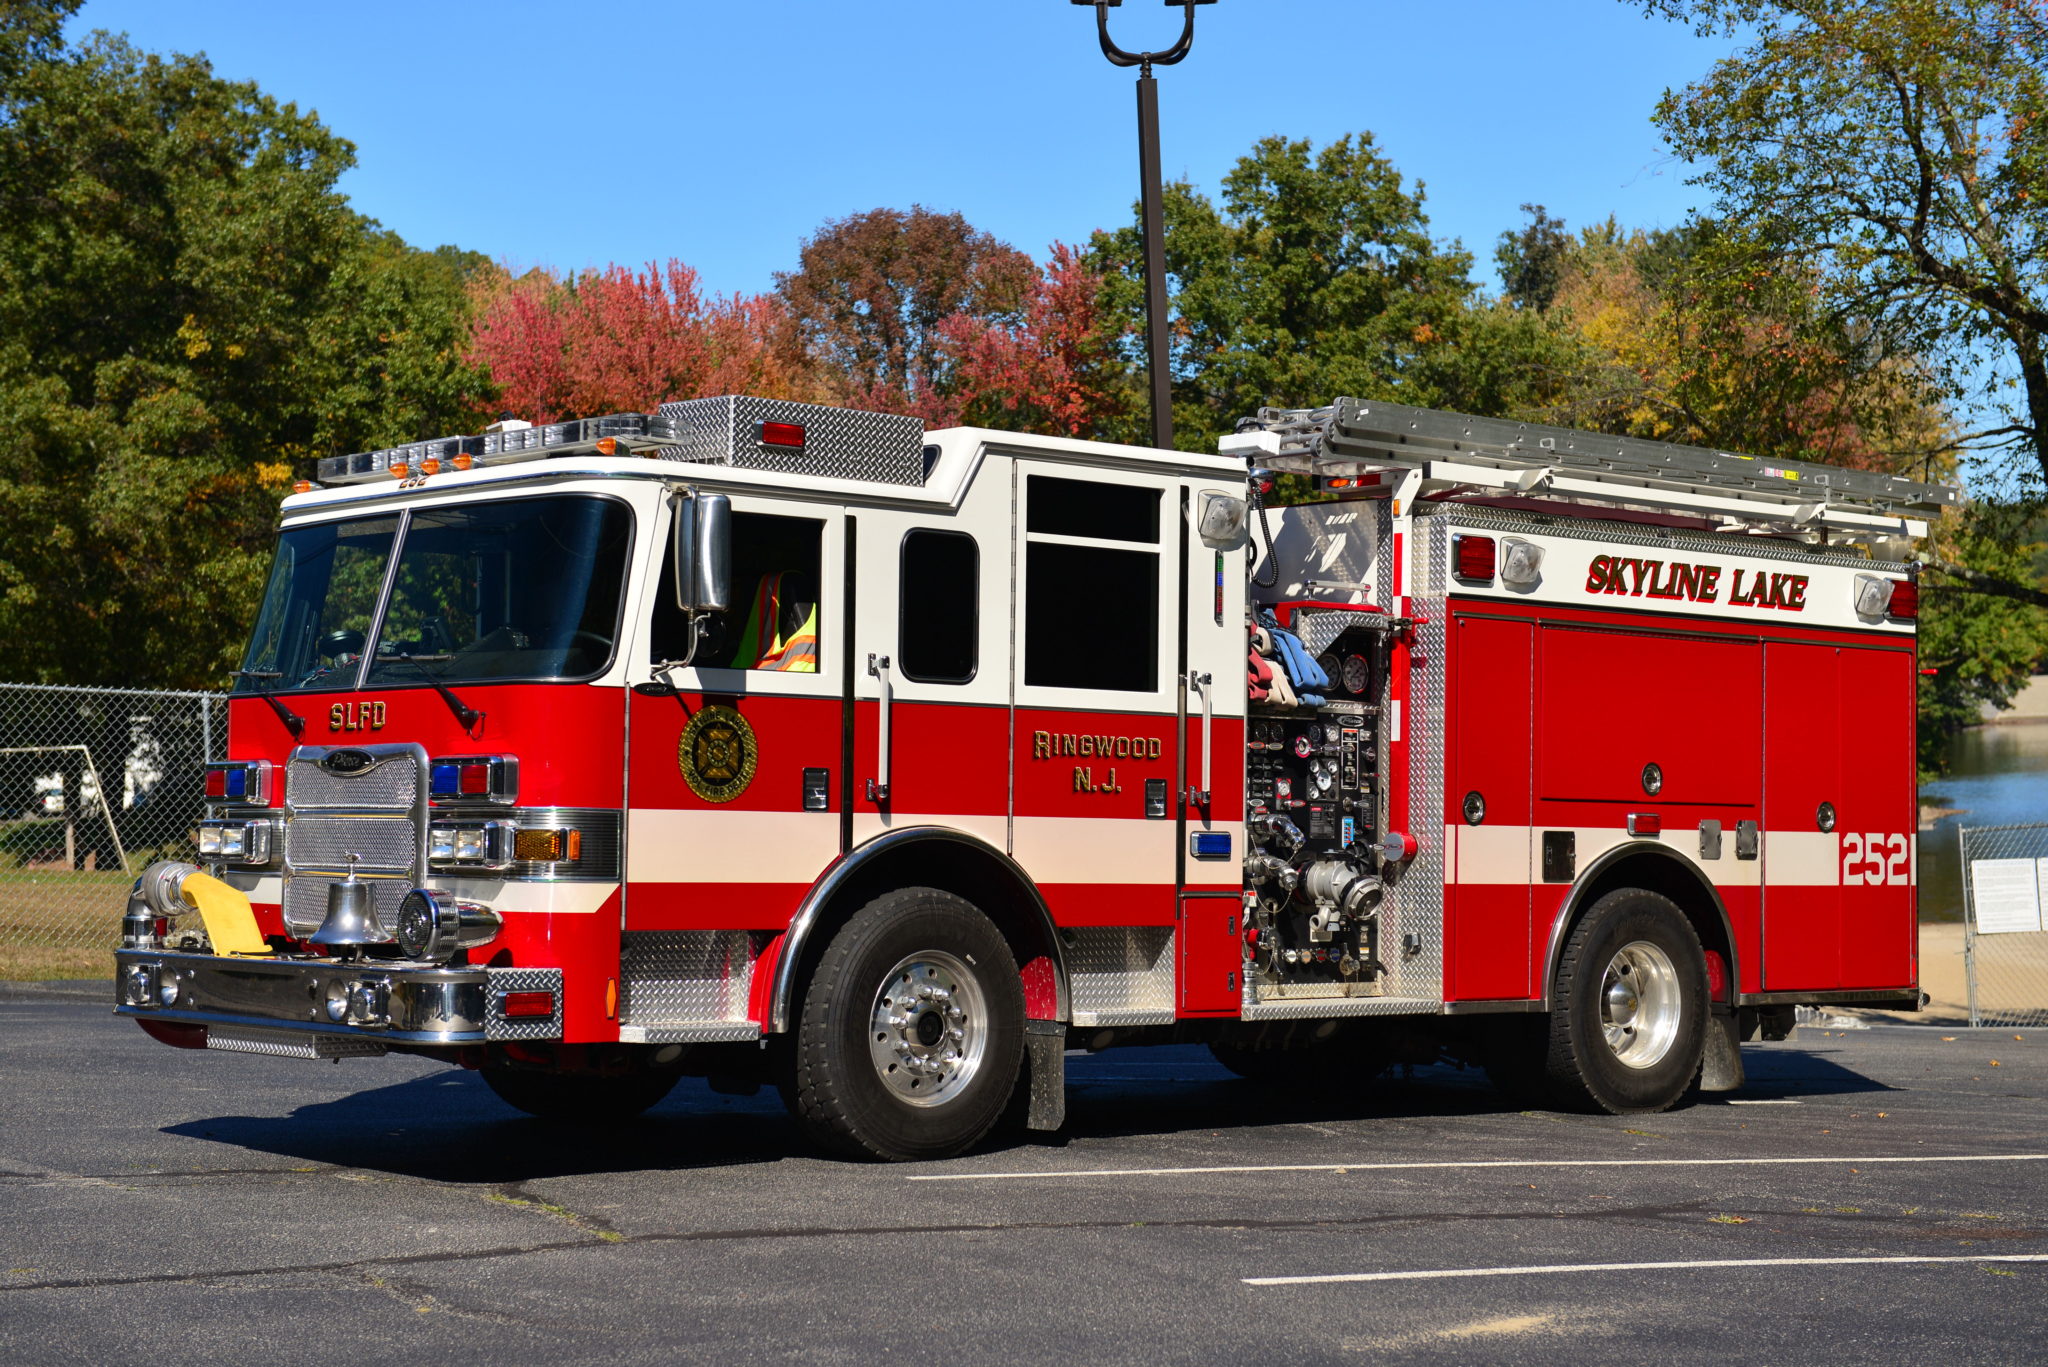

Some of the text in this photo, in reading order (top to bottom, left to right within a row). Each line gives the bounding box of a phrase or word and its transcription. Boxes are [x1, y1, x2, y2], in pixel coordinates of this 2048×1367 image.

[1586, 555, 1809, 612] SKYLINE LAKE
[330, 701, 386, 730] SLFD
[1034, 730, 1162, 759] RINGWOOD
[704, 786, 725, 798] FIRE
[1074, 766, 1122, 792] N.J.
[1842, 832, 1908, 886] 252
